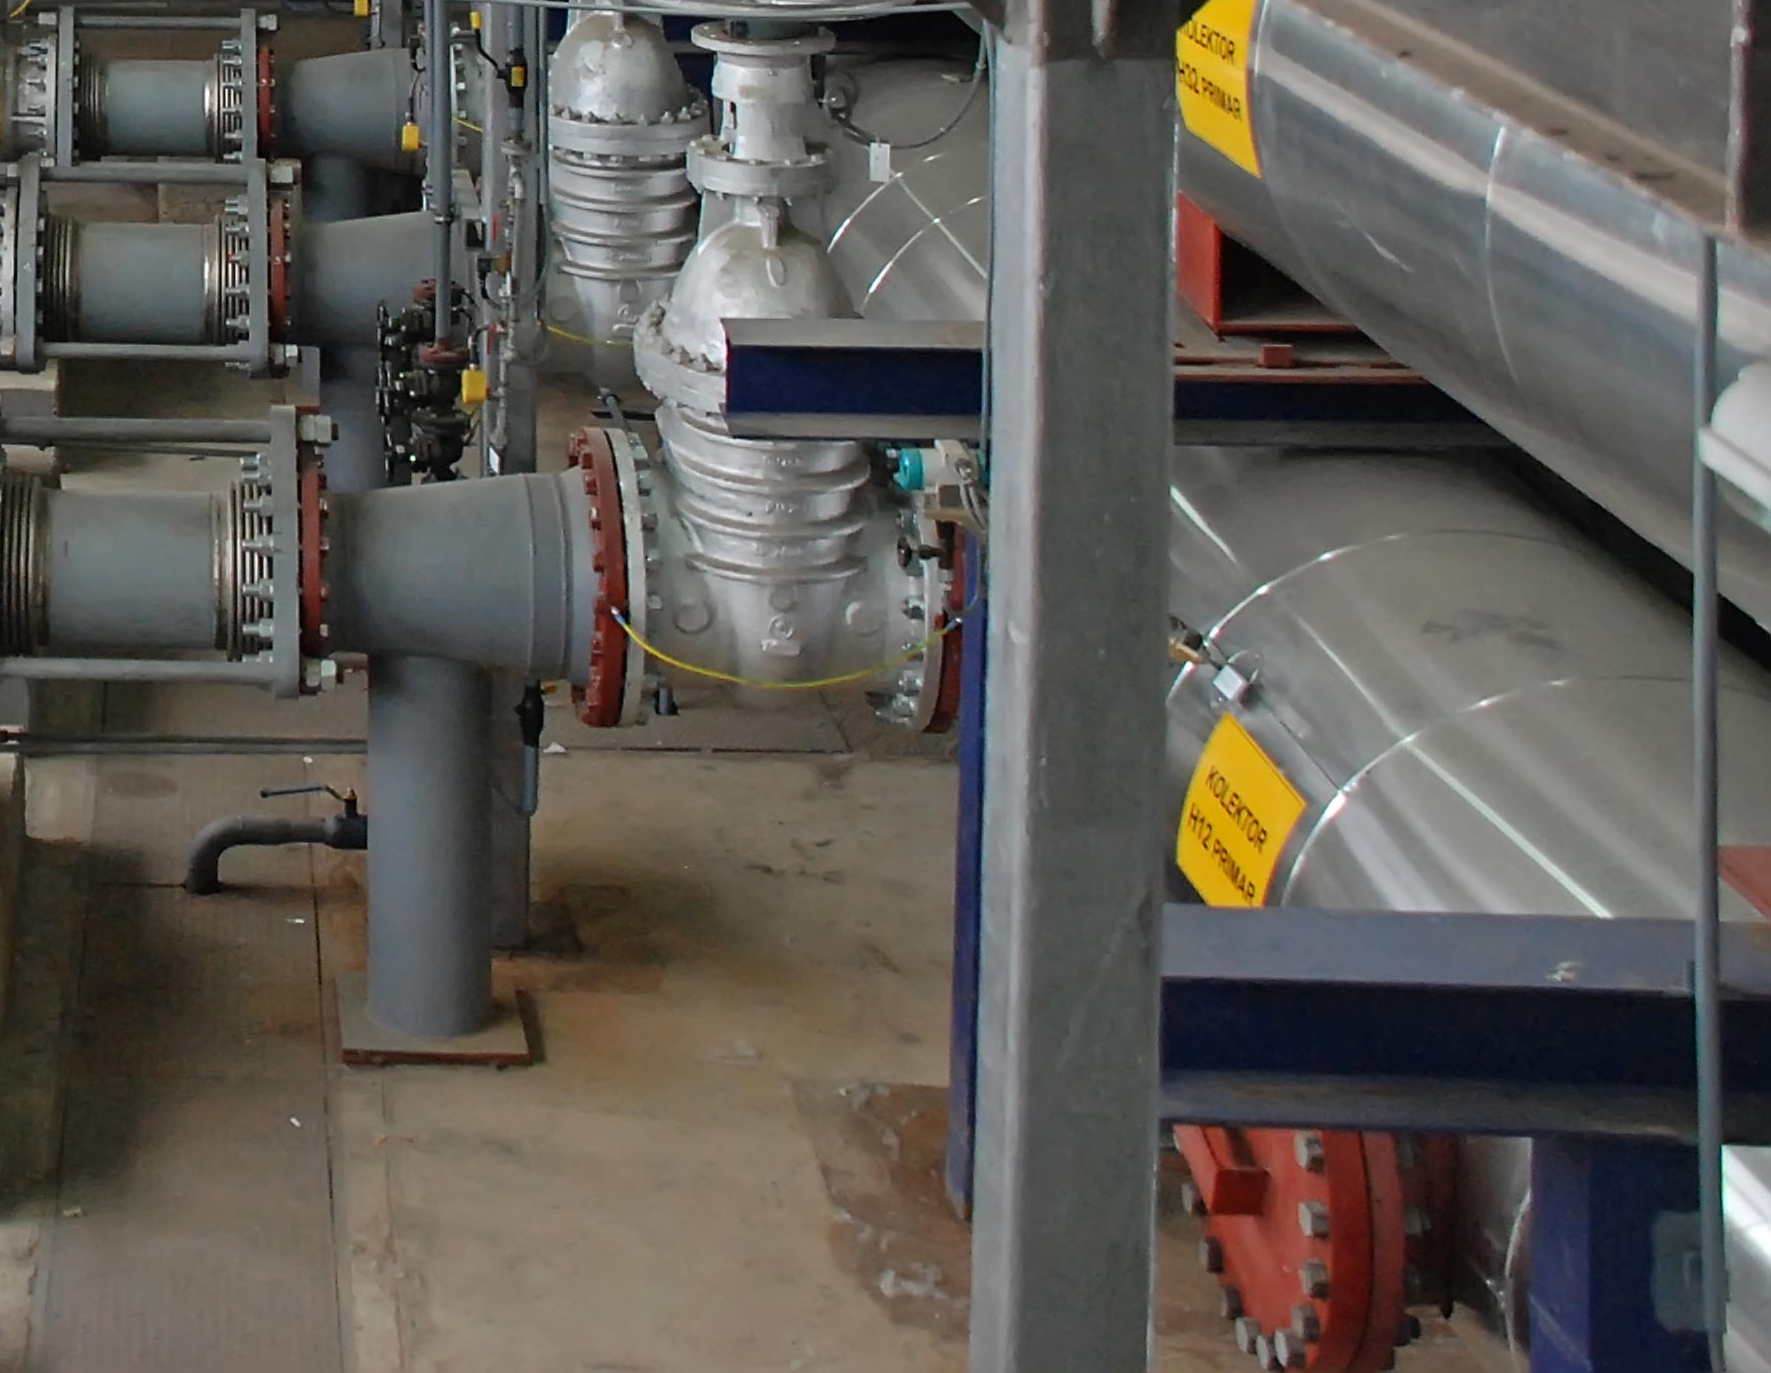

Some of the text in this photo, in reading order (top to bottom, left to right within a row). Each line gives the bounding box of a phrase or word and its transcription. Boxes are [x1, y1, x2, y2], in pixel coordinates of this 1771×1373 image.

[1202, 77, 1242, 122] PRIMAR
[1187, 803, 1256, 904] H12 PRIMAR
[1206, 765, 1269, 854] KOLEKTOR
